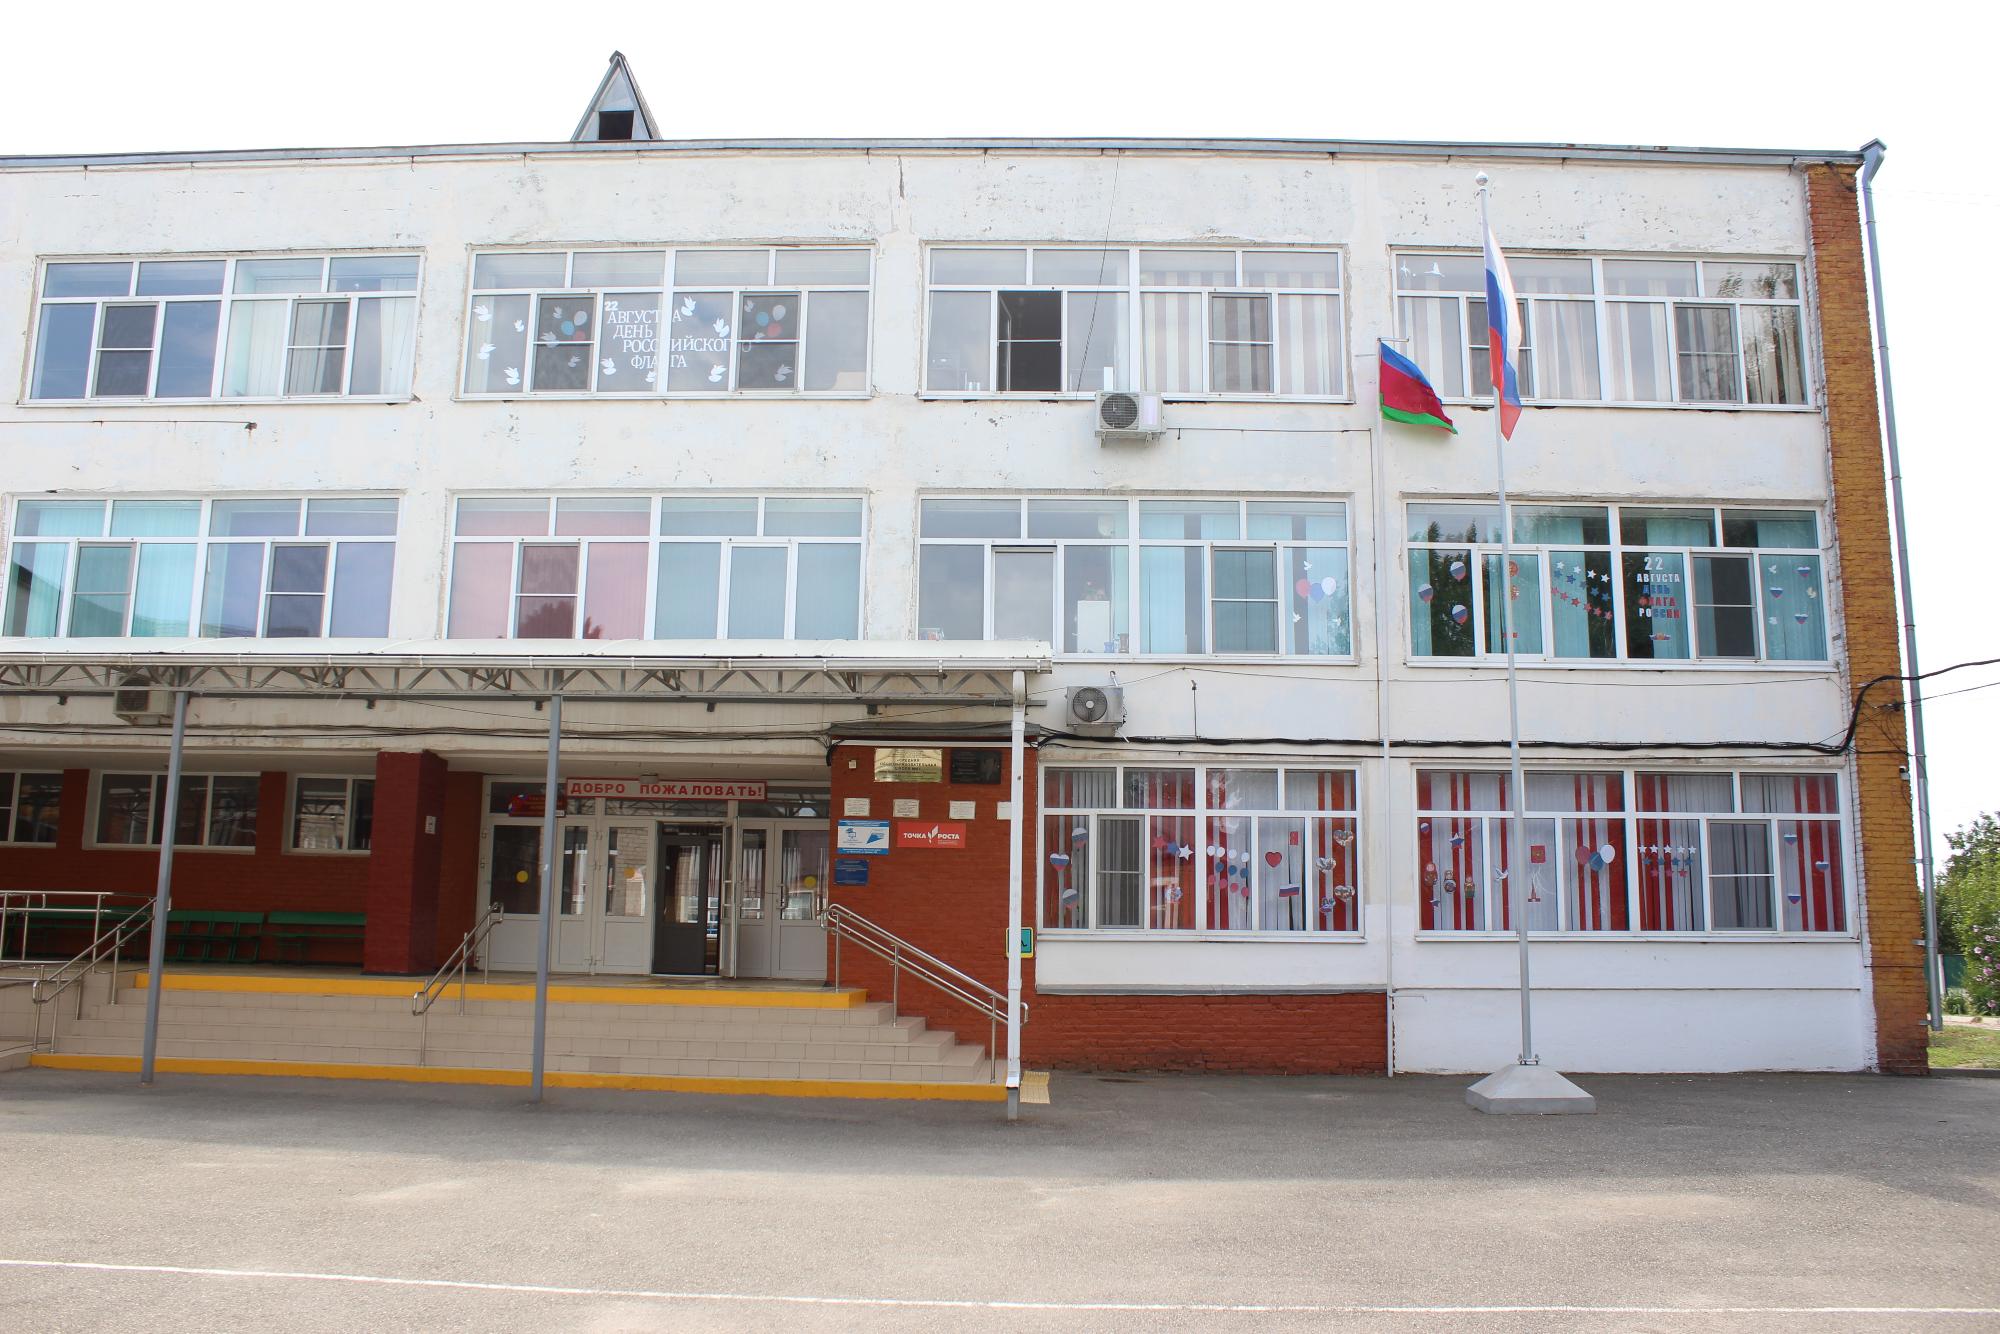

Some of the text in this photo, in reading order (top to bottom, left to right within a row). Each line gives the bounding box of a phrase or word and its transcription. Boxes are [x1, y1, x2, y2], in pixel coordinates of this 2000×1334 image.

[604, 300, 619, 312] 22
[608, 309, 681, 323] АВГУСТА
[613, 325, 653, 339] ДЕНЬ
[631, 354, 688, 369] ФЛАГА
[1644, 557, 1663, 570] 22
[1636, 573, 1680, 583] АВГУСТА
[1639, 607, 1681, 618] РОССИИ
[571, 783, 762, 796] ДОБРО ПОЖАЛОВАТЬ!
